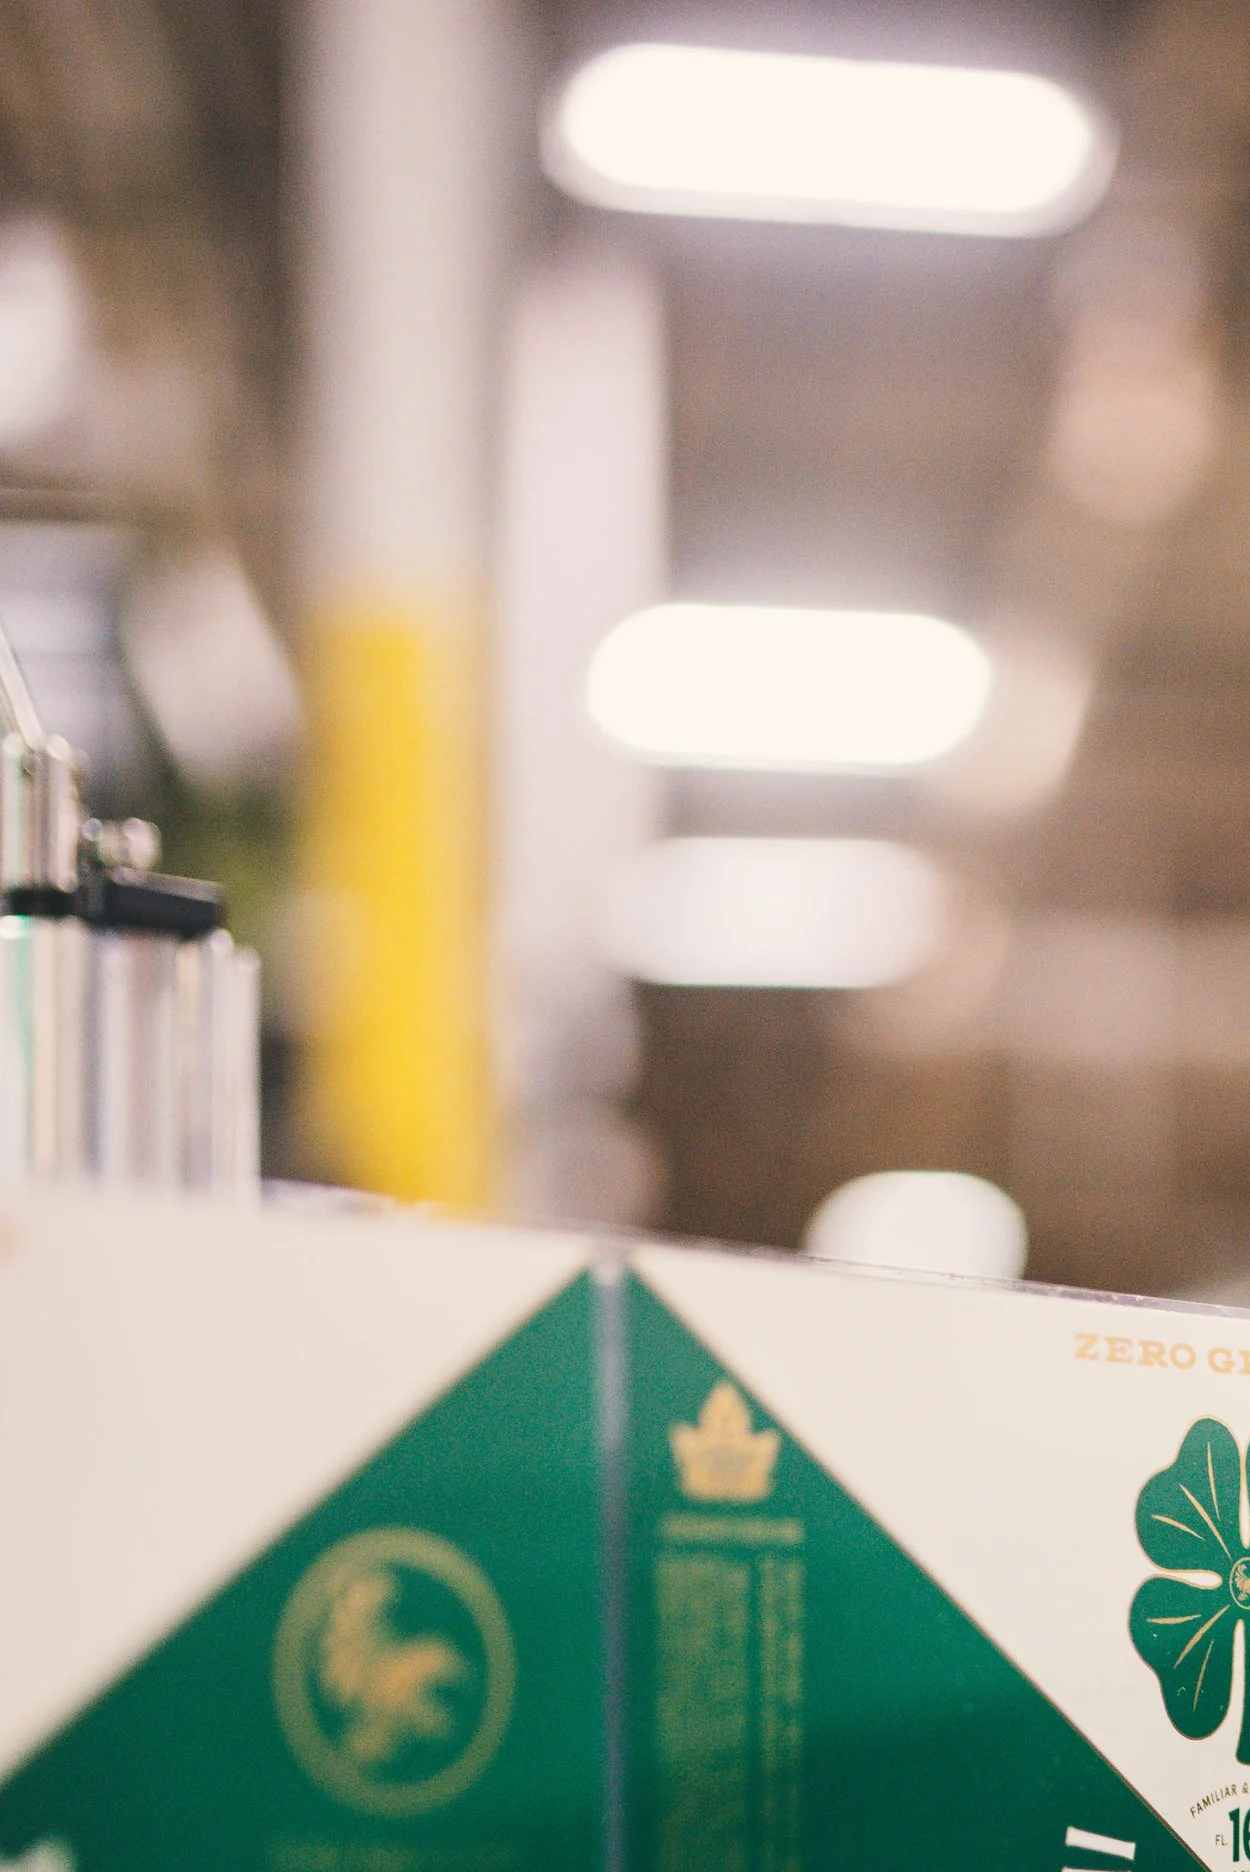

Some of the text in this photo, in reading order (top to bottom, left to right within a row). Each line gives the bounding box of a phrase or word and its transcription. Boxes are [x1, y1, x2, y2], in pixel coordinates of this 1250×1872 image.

[1074, 1332, 1197, 1371] ZERO
[1190, 1784, 1237, 1819] FAMILIAR
[1242, 1782, 1249, 1794] &
